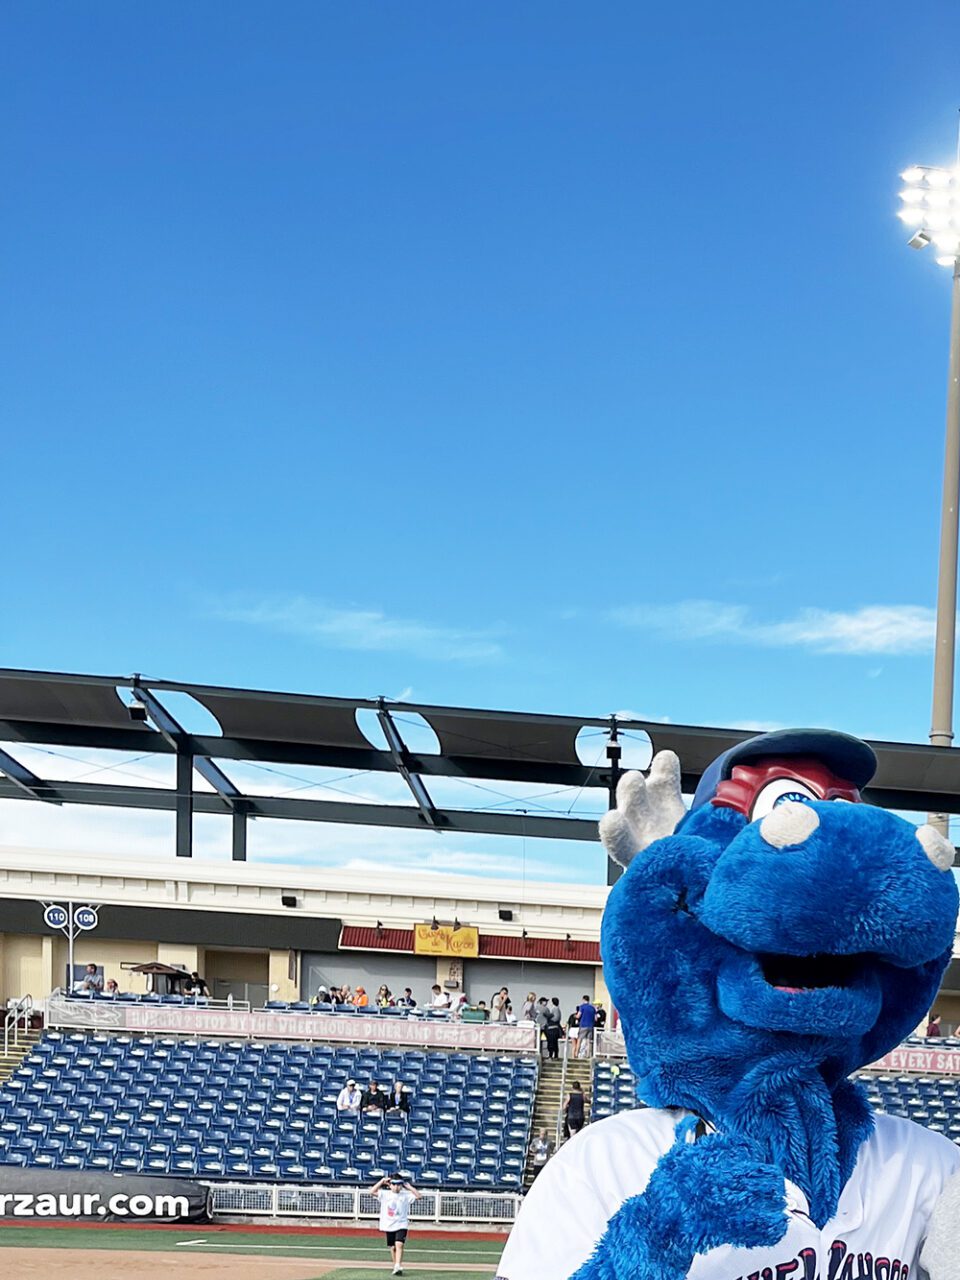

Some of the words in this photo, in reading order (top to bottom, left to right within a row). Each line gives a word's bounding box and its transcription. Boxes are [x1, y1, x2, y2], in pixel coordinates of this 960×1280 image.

[49, 912, 65, 921] 110
[195, 1014, 227, 1030] STOP
[251, 1016, 273, 1032] THE
[364, 1022, 402, 1039] DINER
[406, 1023, 432, 1041] AND
[890, 1052, 933, 1069] EVERY
